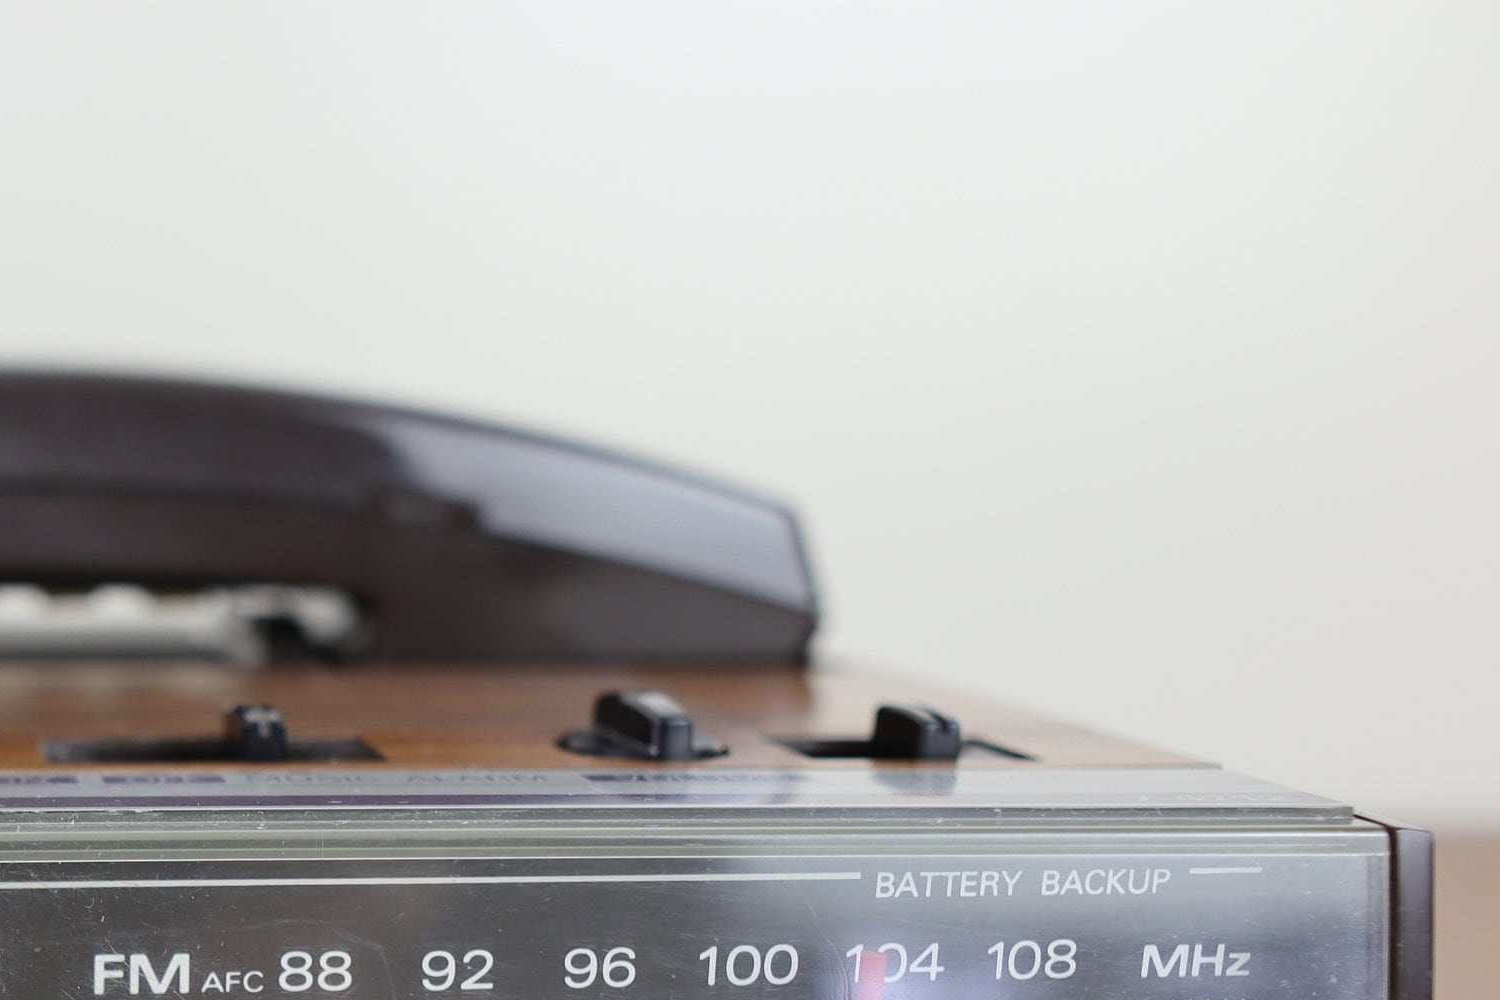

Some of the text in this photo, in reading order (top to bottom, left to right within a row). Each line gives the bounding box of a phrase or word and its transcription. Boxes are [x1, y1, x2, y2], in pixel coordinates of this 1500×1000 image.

[875, 869, 1171, 898] BATTERY BACKUP
[93, 939, 1251, 995] FM AFC 88 92 96 100 104 108 MHz
